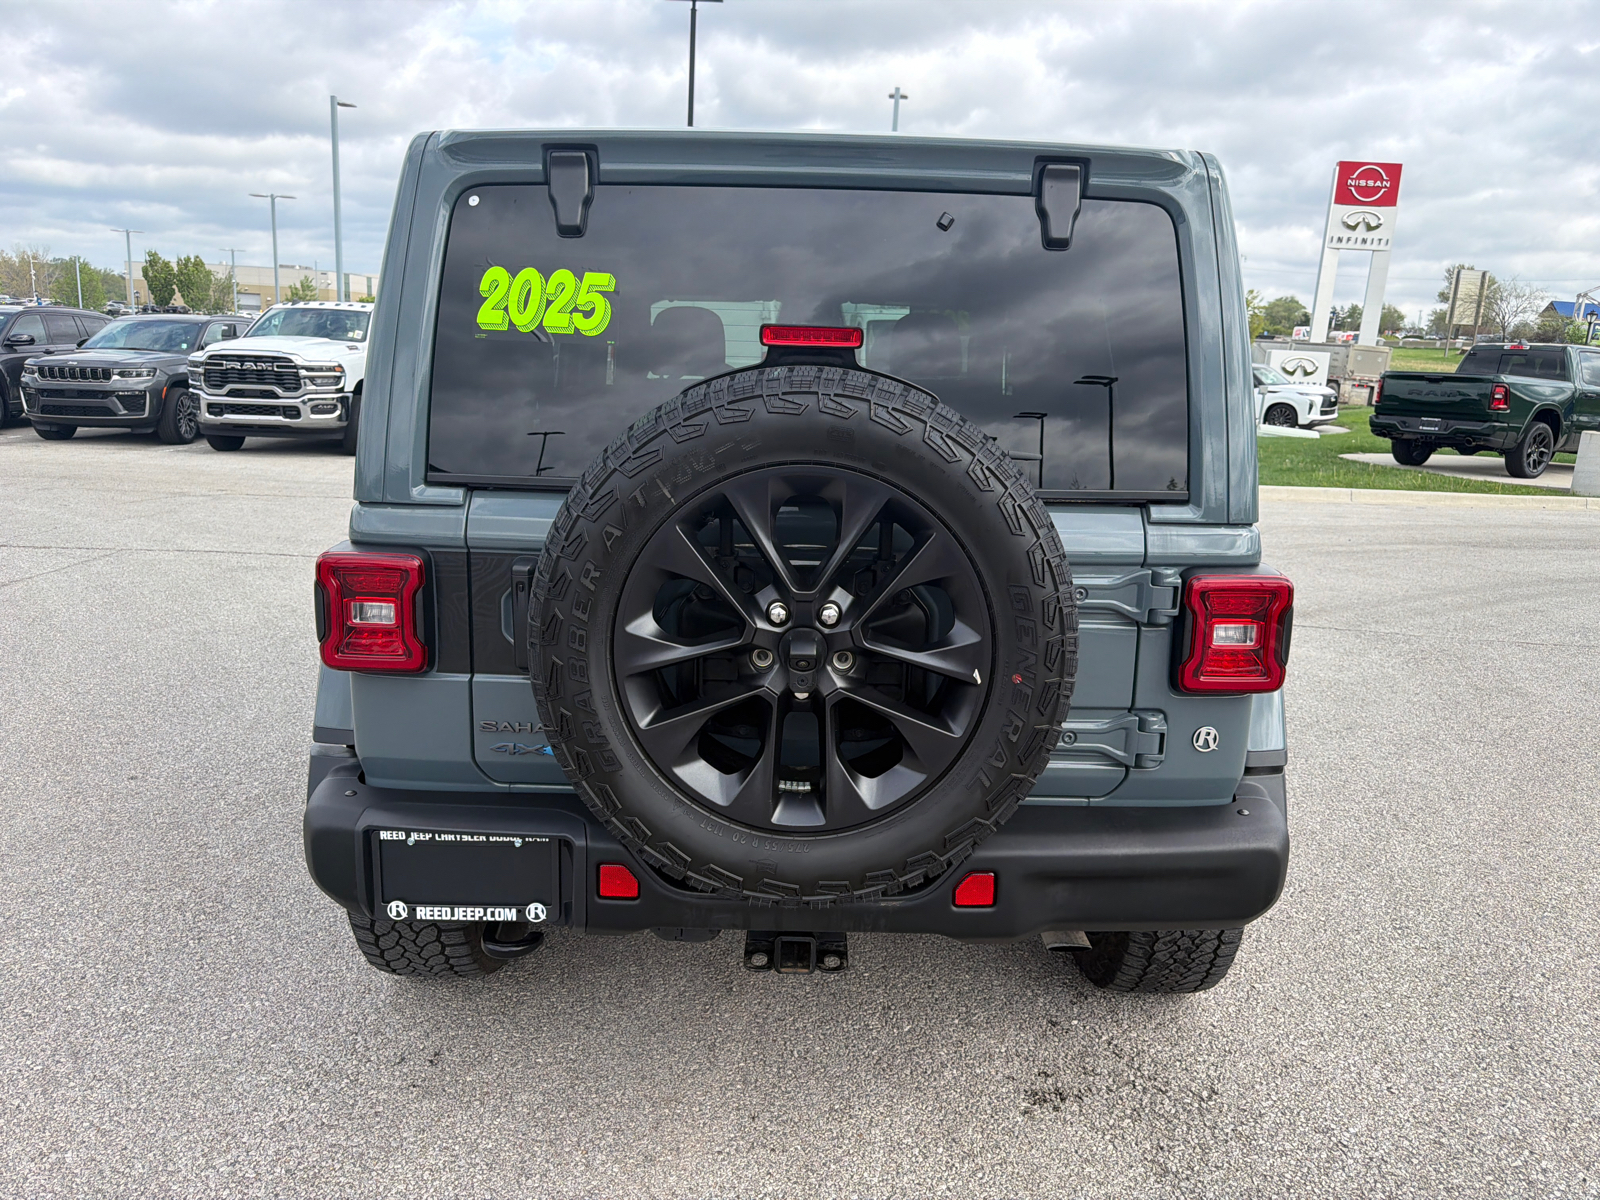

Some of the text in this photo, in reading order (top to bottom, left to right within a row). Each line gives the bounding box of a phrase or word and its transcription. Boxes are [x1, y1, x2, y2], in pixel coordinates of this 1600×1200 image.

[1347, 179, 1390, 188] NISSAN
[1330, 236, 1389, 246] INFINITI
[477, 266, 616, 337] 2025
[226, 362, 273, 370] RAM
[1407, 389, 1460, 398] RAM
[568, 480, 650, 772] GRABBER A/T
[966, 584, 1038, 790] GENERAL
[479, 721, 544, 733] SAHA
[489, 742, 554, 756] 4X
[700, 818, 723, 837] 113T
[380, 830, 406, 840] REED
[732, 832, 746, 844] 20
[752, 837, 759, 848] R
[764, 840, 810, 853] 275/55
[416, 906, 517, 921] REEDJEEP.COM
